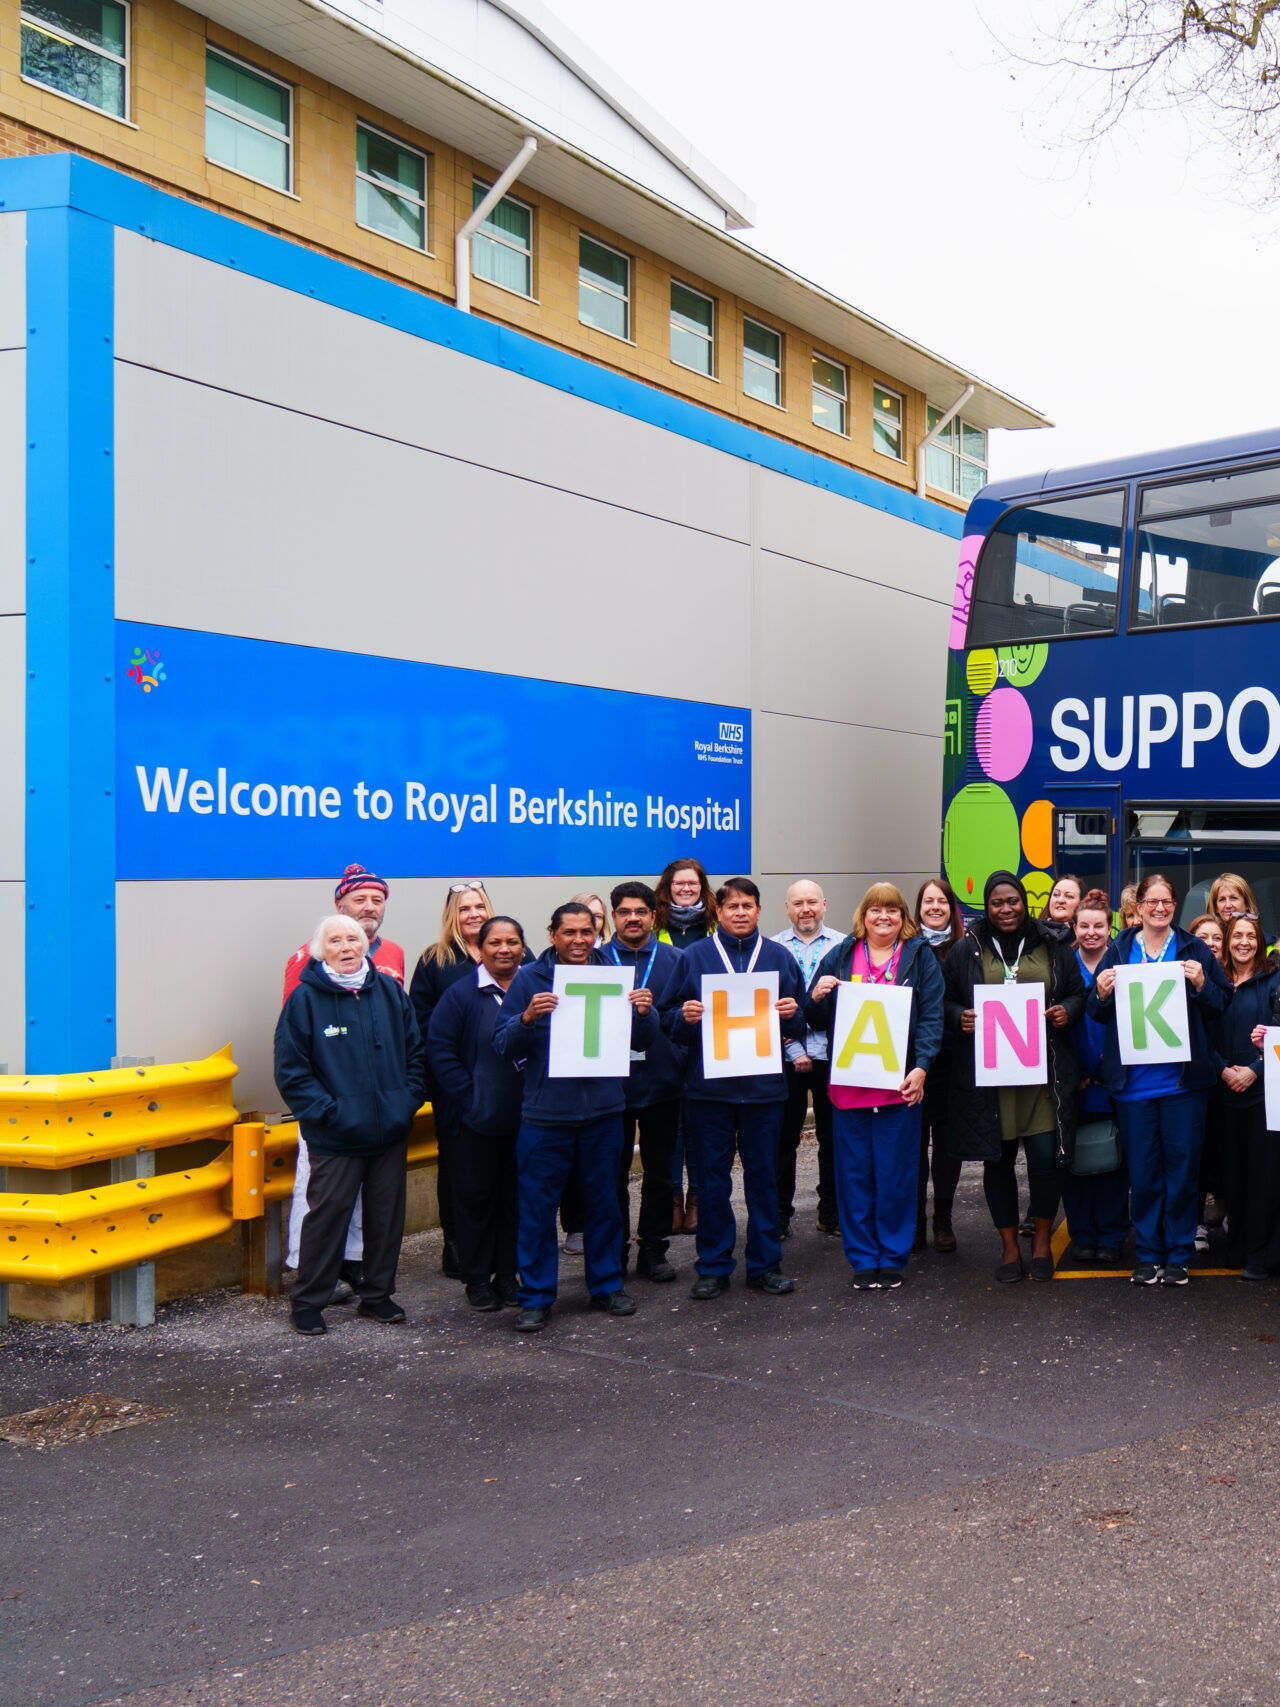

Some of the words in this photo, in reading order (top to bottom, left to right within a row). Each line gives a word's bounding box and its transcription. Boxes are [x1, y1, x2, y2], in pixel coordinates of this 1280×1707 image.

[994, 658, 1017, 677] 1210
[720, 723, 743, 742] NHS
[694, 740, 713, 753] Royal
[714, 743, 743, 755] Berkshire
[135, 766, 342, 818] Welcome
[354, 781, 393, 820] to
[405, 782, 497, 832] Royal
[509, 788, 637, 828] Berkshire
[646, 796, 740, 838] Hospital
